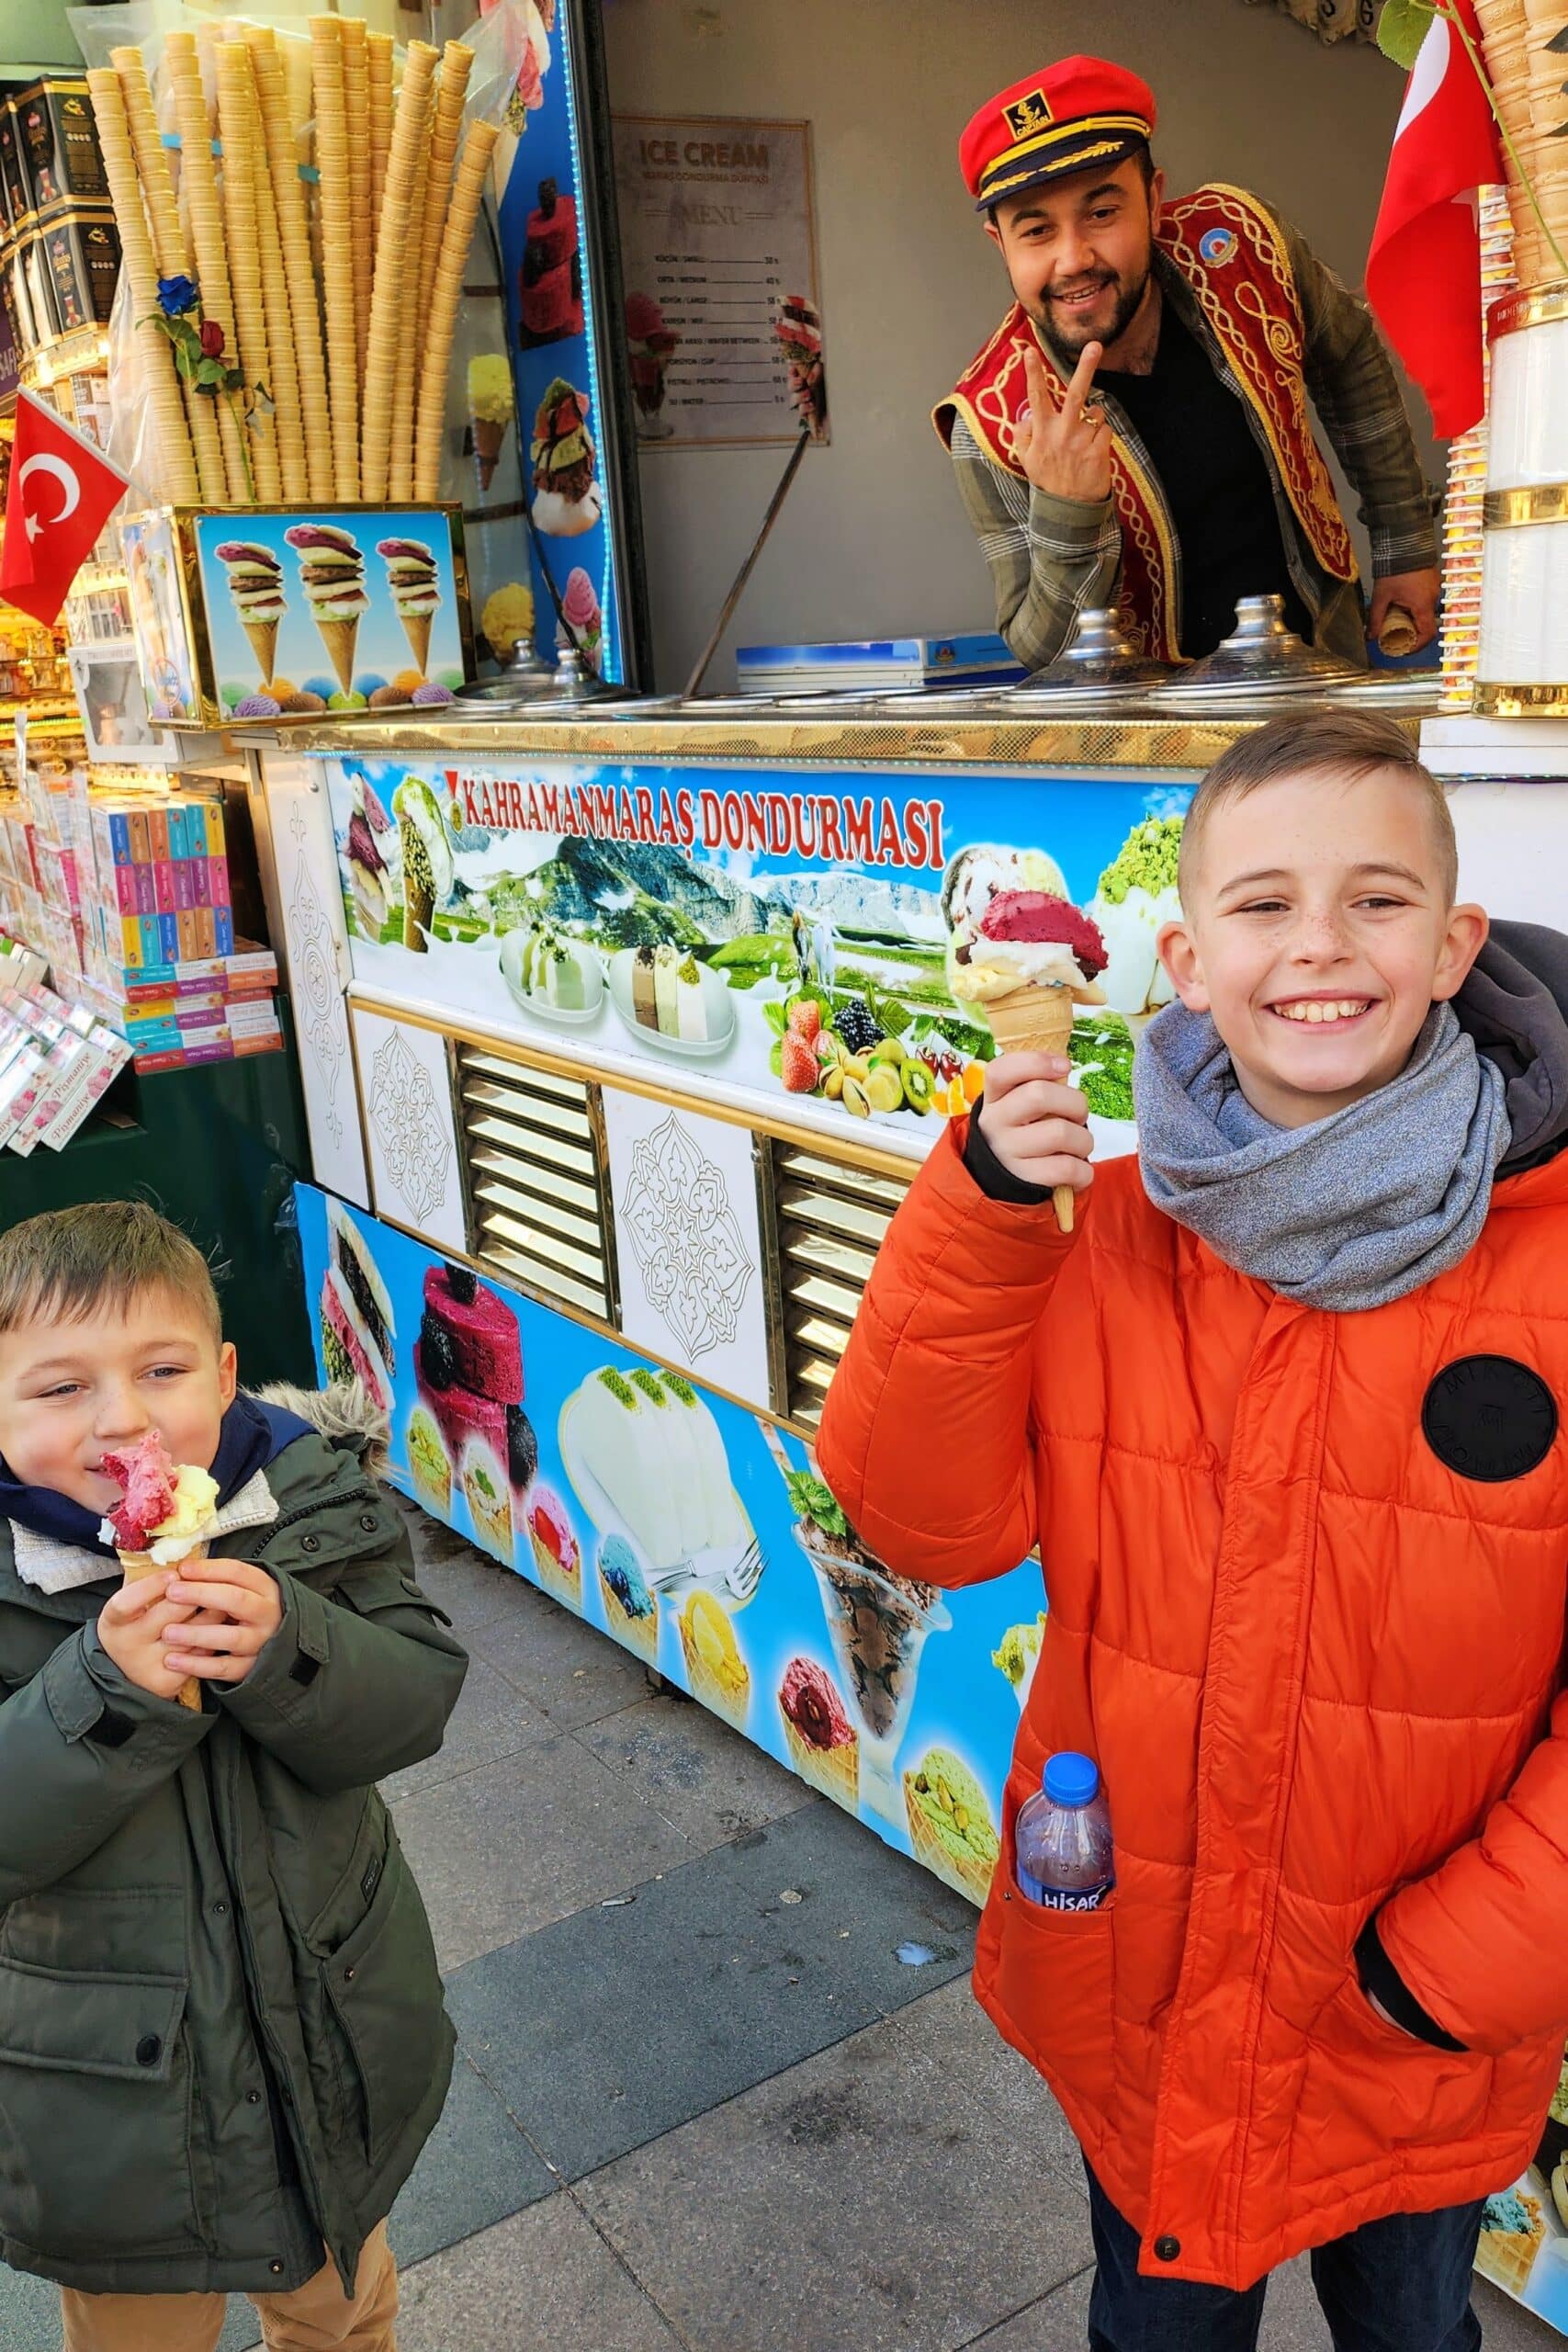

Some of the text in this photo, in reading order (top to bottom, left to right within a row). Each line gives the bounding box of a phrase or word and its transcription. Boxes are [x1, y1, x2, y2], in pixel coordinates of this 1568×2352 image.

[638, 139, 770, 171] ICE CREAM
[462, 779, 945, 869] KAHRAMANMARAŞ DONDURMASI
